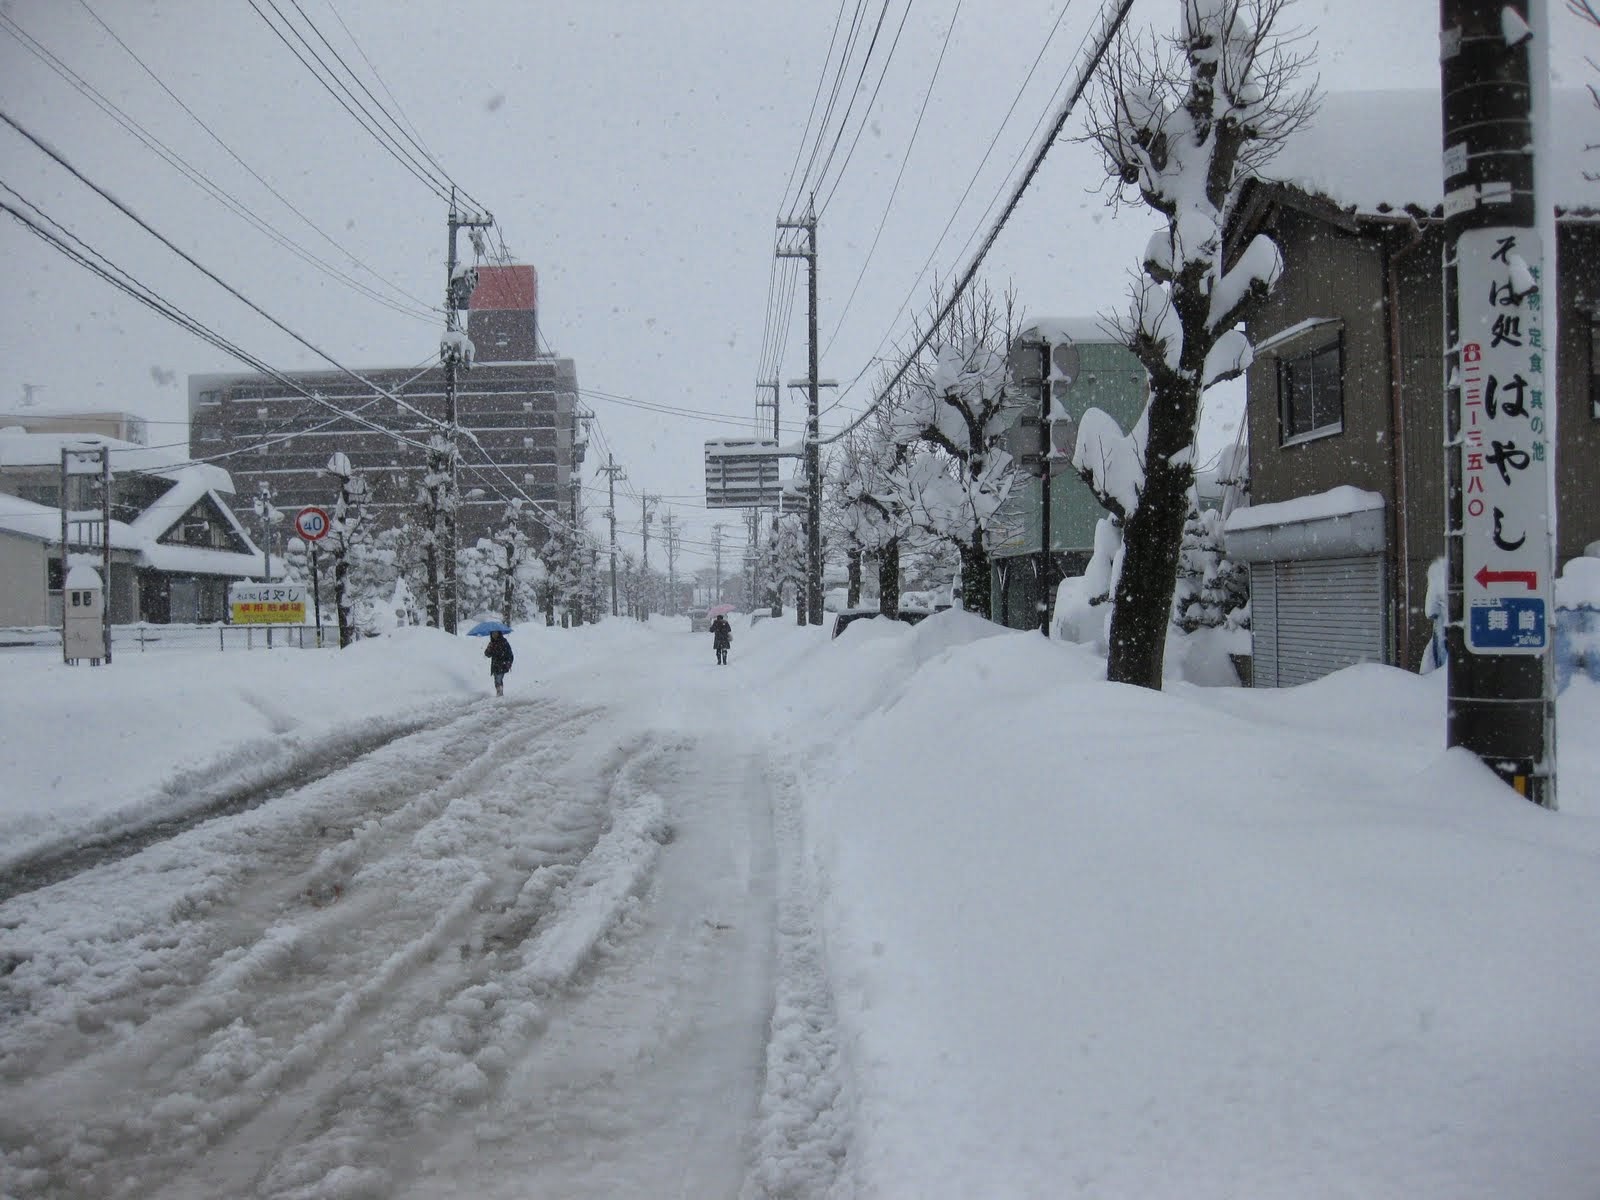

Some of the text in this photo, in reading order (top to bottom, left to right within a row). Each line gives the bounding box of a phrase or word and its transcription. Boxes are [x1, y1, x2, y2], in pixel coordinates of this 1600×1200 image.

[1530, 389, 1545, 462] 其の他
[1484, 373, 1531, 552] はやし
[304, 517, 322, 531] 40
[259, 589, 299, 601] はやし
